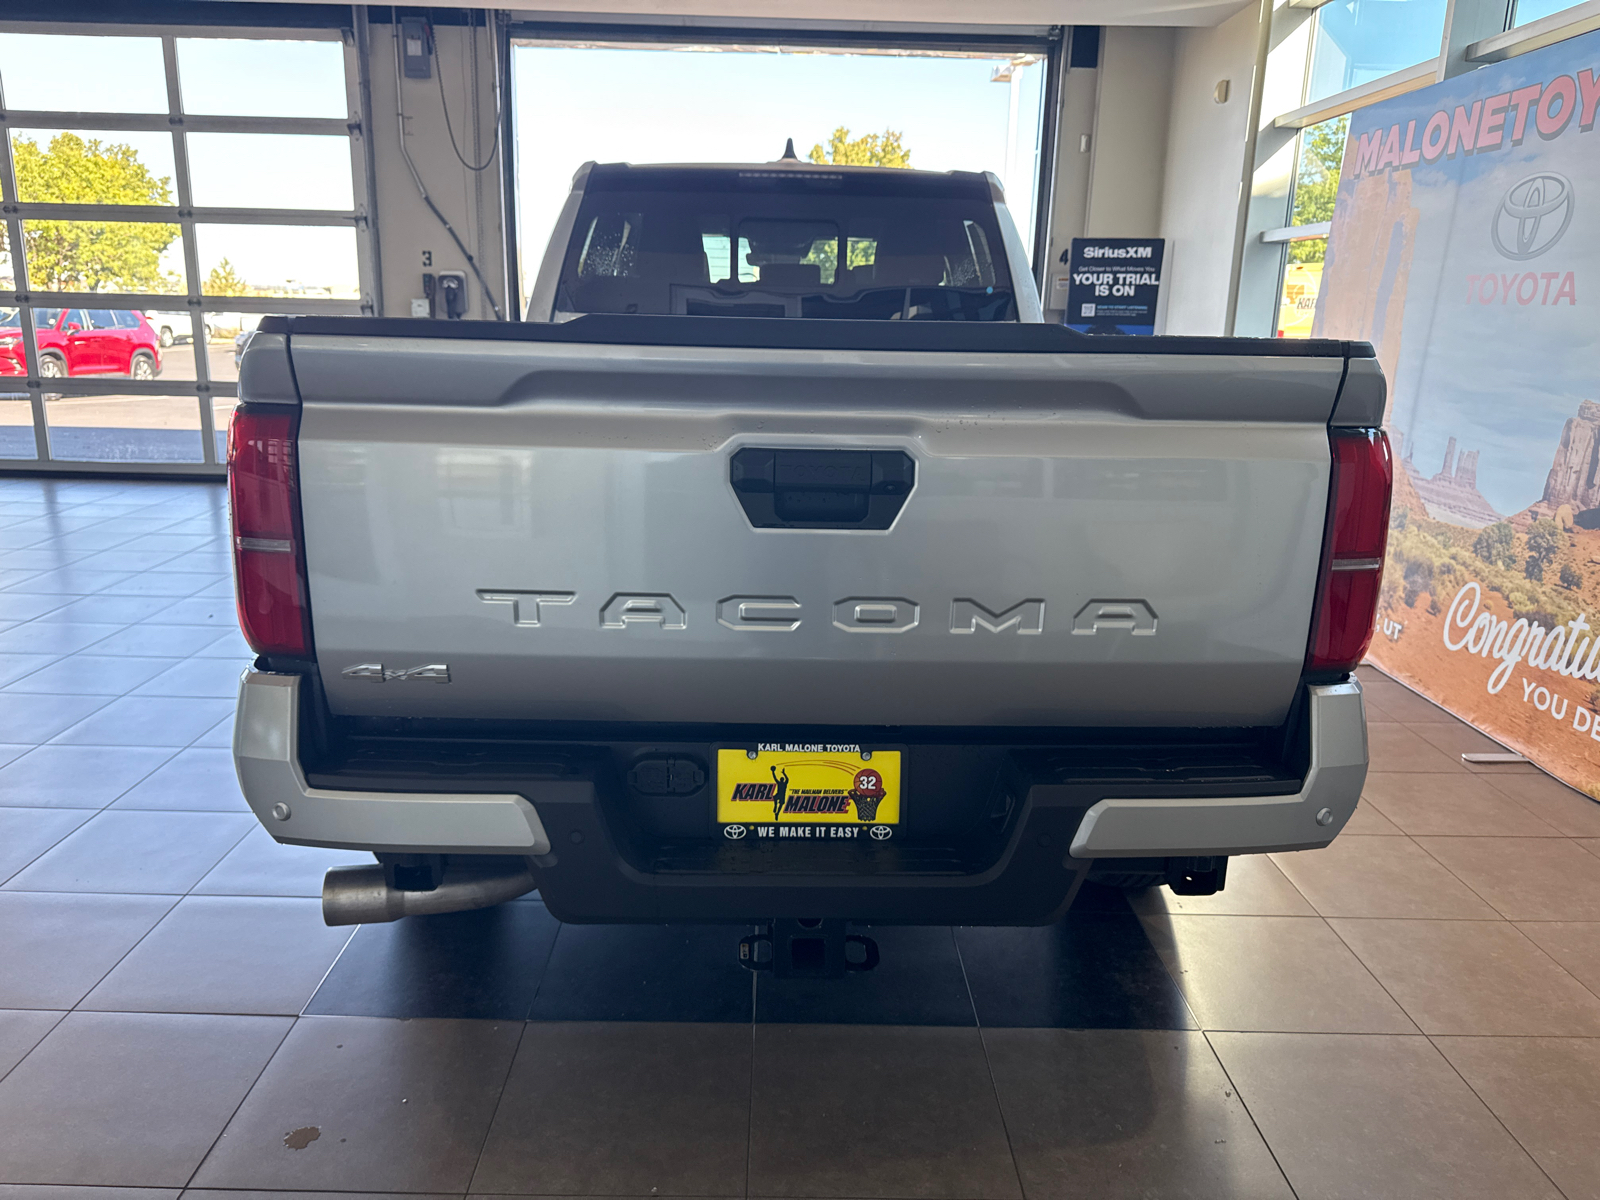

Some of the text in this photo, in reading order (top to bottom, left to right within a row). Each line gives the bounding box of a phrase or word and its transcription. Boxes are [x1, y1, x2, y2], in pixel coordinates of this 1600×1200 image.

[422, 250, 432, 267] 3
[1059, 248, 1069, 265] 4
[1083, 246, 1152, 258] SiriusXM
[1073, 273, 1159, 285] YOUR TRIAL
[1095, 285, 1135, 296] IS ON
[1465, 271, 1577, 306] TOYOTA
[780, 464, 866, 481] TOYOTA
[475, 588, 1159, 635] TACOMA
[1383, 617, 1402, 640] UT
[1522, 678, 1568, 720] YOU
[758, 743, 861, 753] KARL MALONE TOYOTA
[859, 776, 877, 790] 32
[731, 783, 776, 801] KARL
[783, 795, 850, 813] MALONE
[757, 827, 859, 838] WE MAKE IT EASY
